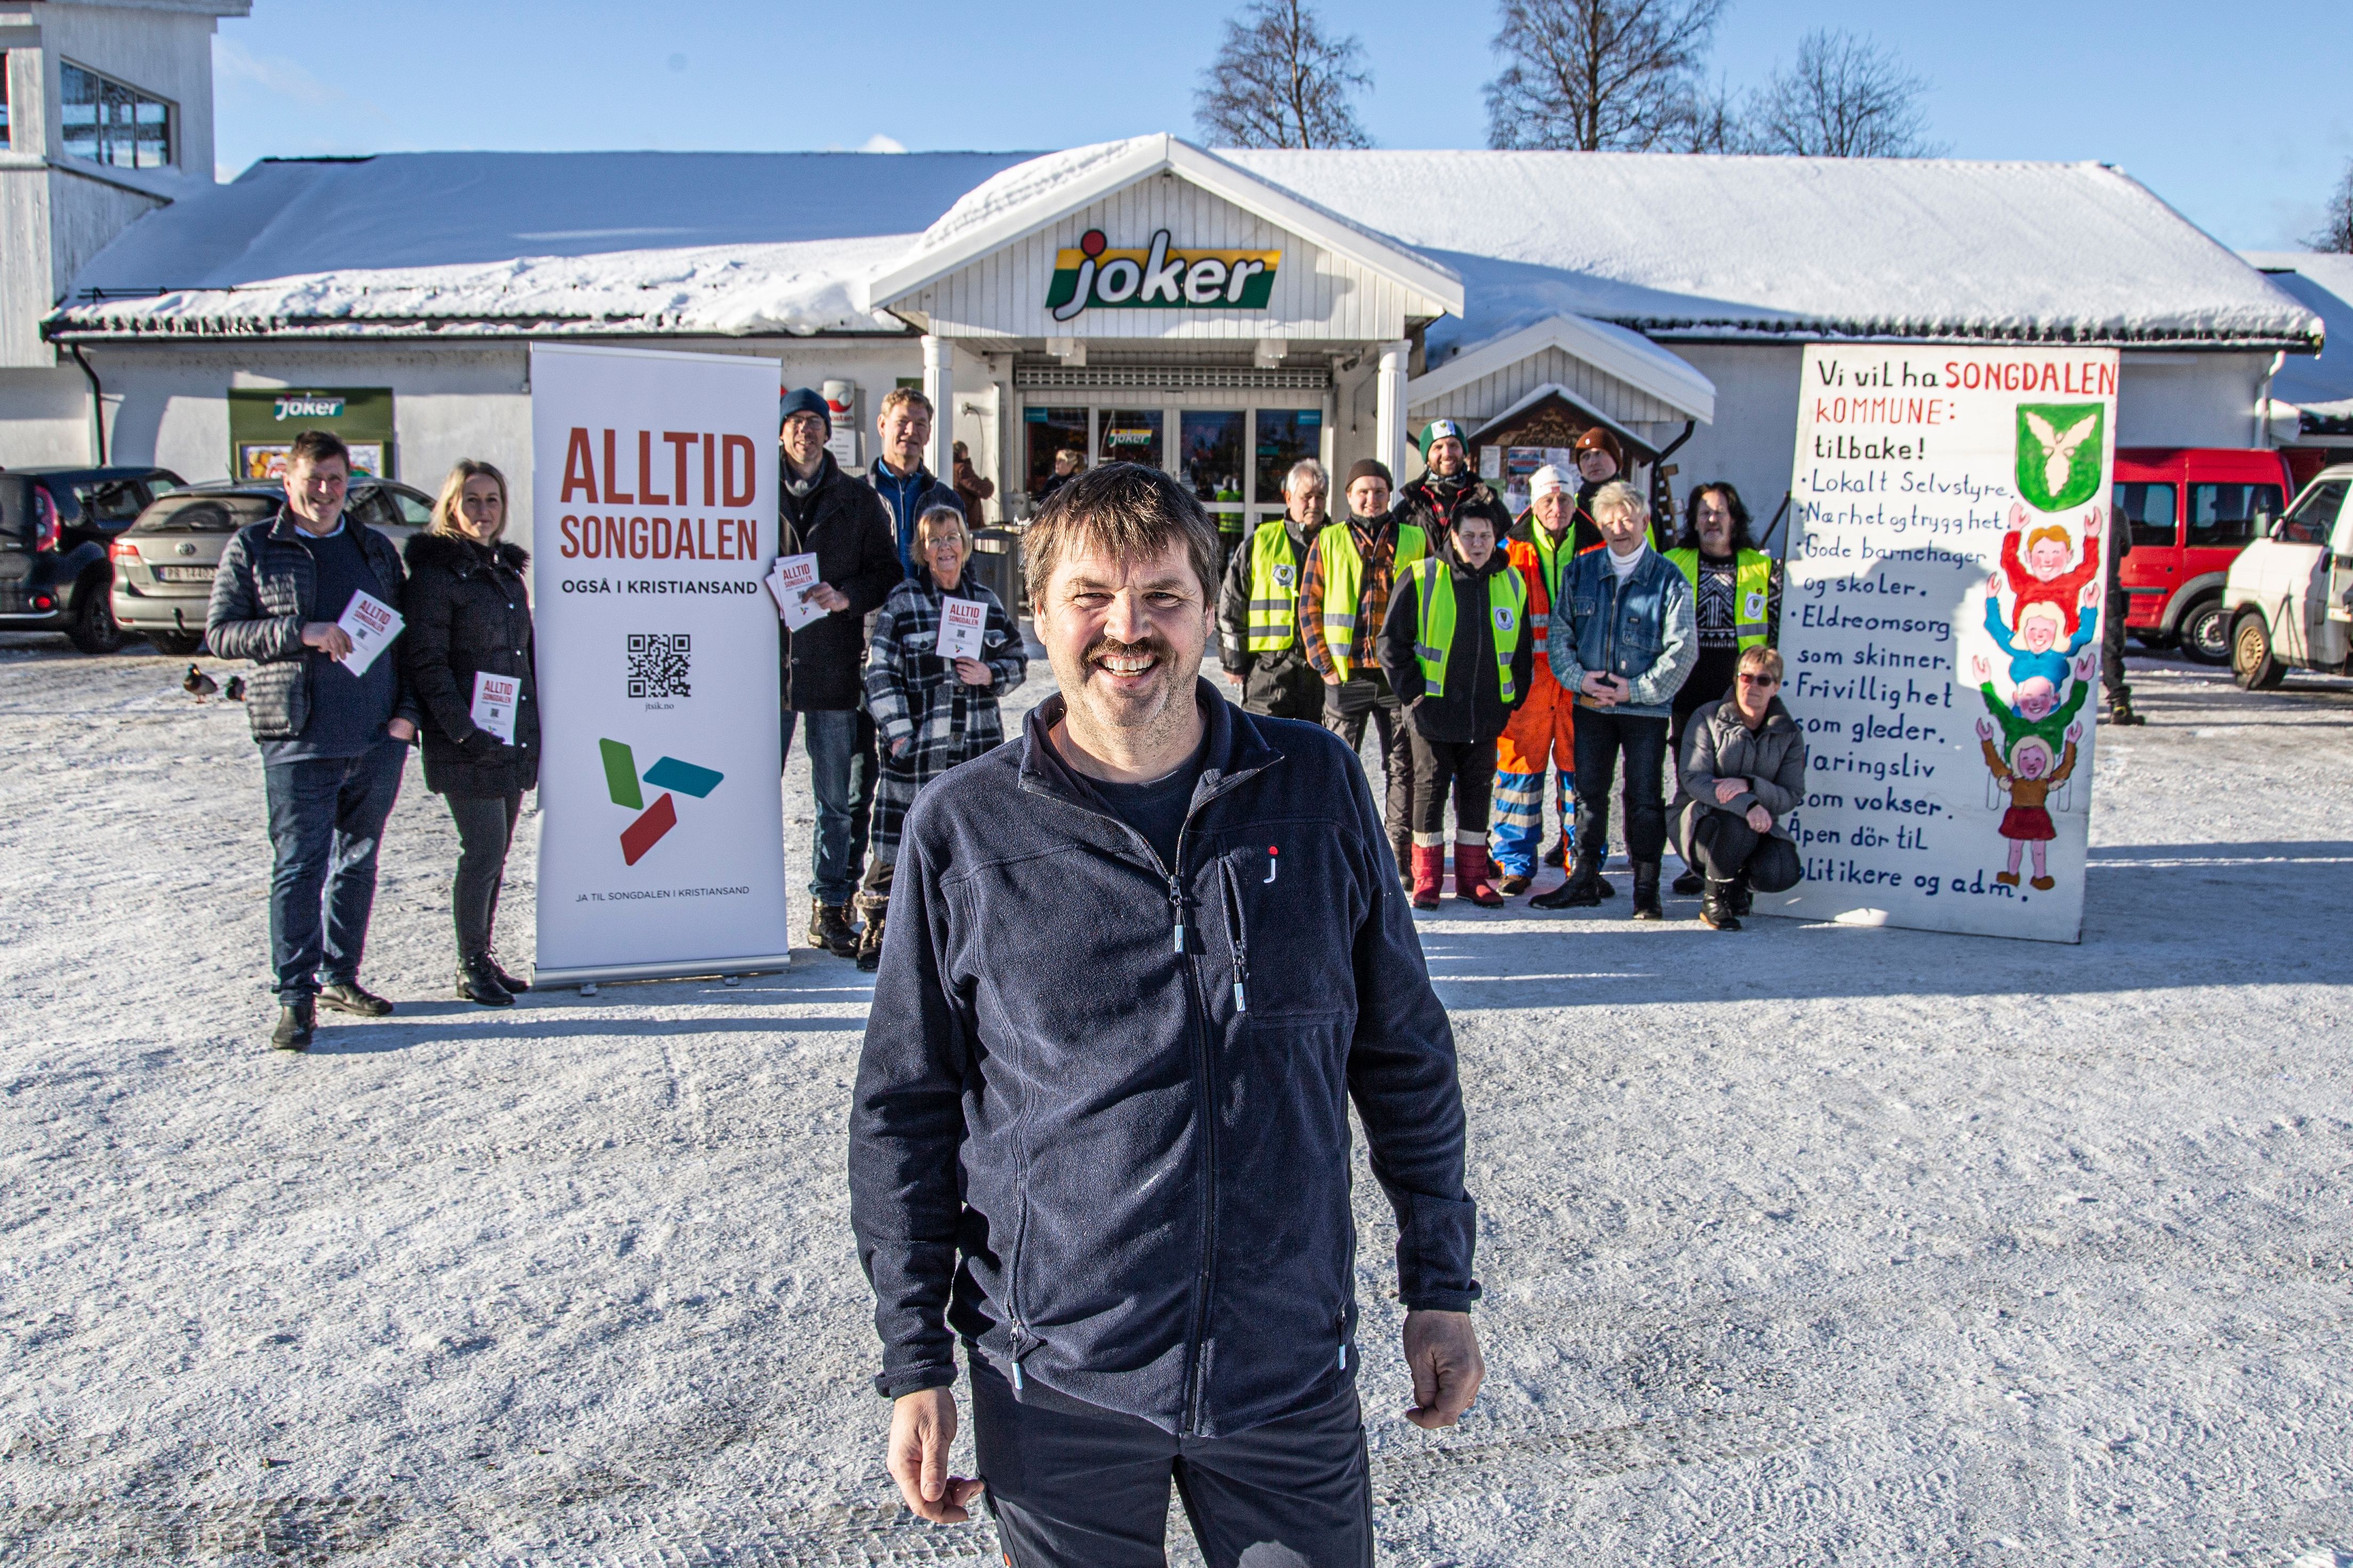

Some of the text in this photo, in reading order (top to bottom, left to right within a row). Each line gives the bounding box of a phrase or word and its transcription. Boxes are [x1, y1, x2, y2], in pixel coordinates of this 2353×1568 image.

[1052, 229, 1265, 320] joker
[1818, 360, 1843, 387] Vi
[1902, 361, 1940, 387] ha
[1946, 361, 2117, 395] SONGDALEN
[275, 392, 340, 421] joker
[1109, 429, 1146, 448] joker
[560, 427, 756, 507] ALLTID
[1812, 469, 1887, 493] Lokalt
[1806, 501, 1885, 525] Nærhet
[1891, 516, 1908, 532] og
[560, 515, 757, 561] SONGDALEN
[1805, 533, 1987, 569] Gode barnehager
[562, 578, 758, 594] OGSÅ I KRISTIANSAND
[783, 564, 811, 581] ALLTID
[785, 575, 813, 588] SONGDALEN
[1803, 572, 1927, 598] og skoler.
[358, 600, 392, 625] ALLTID
[948, 615, 979, 626] SONGDALEN
[950, 604, 980, 618] ALLTID
[1802, 604, 1951, 641] Eldreomsorg
[1797, 642, 1951, 670] som skinner.
[484, 680, 513, 695] ALLTID
[1796, 671, 1952, 710] Frivillighet
[1851, 713, 1945, 744] gleder.
[1854, 786, 1953, 820] vokser.
[1788, 810, 1840, 848] Åpen
[1263, 846, 1279, 883] j
[1800, 857, 2028, 902] litikere og adm.
[591, 892, 605, 901] TIL
[608, 890, 670, 900] SONGDALEN
[678, 886, 750, 897] KRISTIANSAND
